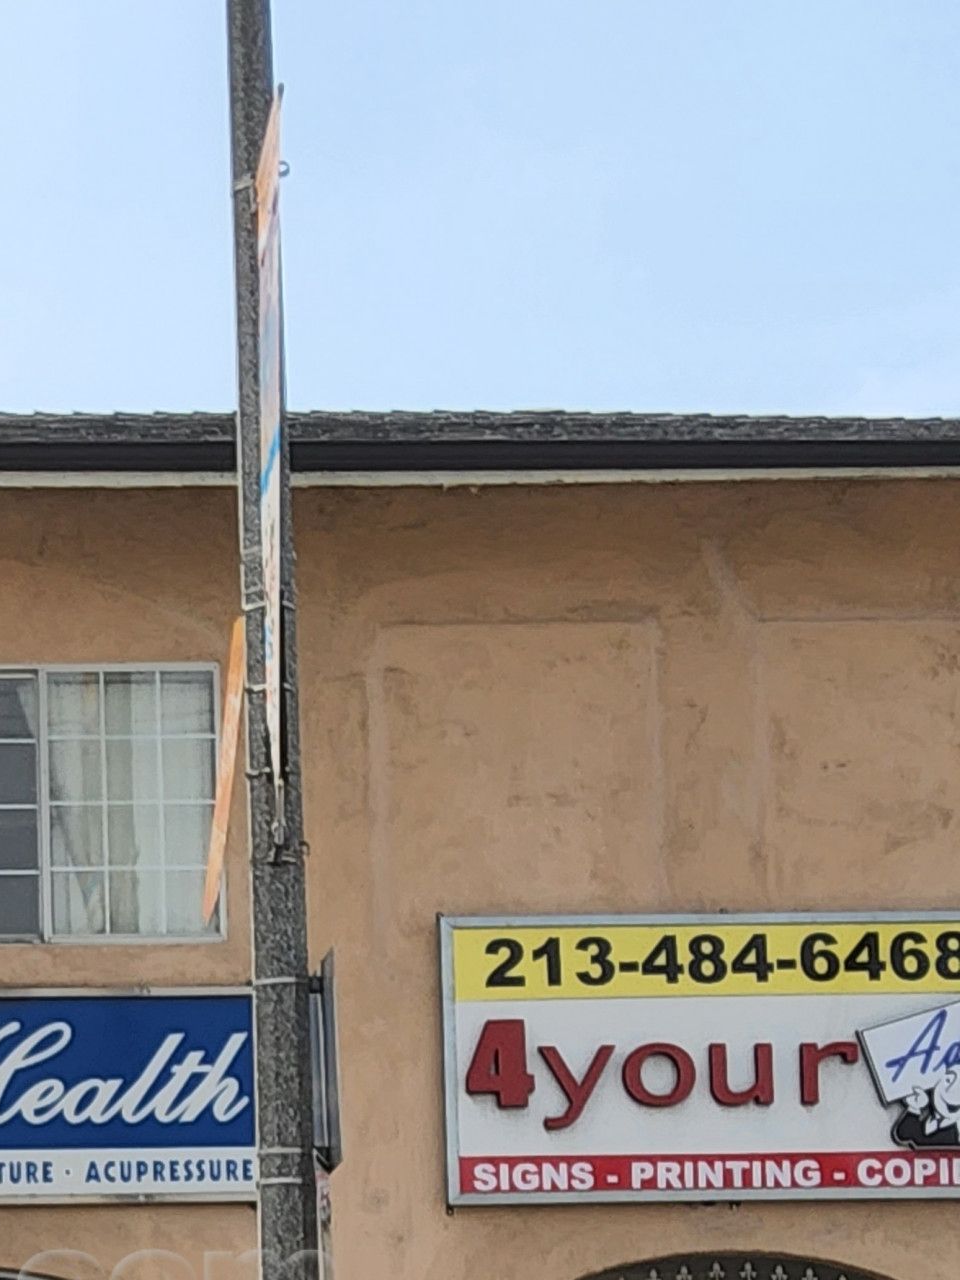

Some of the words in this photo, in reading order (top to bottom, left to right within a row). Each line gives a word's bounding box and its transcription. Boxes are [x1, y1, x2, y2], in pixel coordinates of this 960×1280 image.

[484, 932, 960, 988] 213-484-6468
[84, 1157, 255, 1185] ACUPRESSURE
[473, 1162, 595, 1192] SIGNS
[631, 1159, 822, 1189] PRINTING
